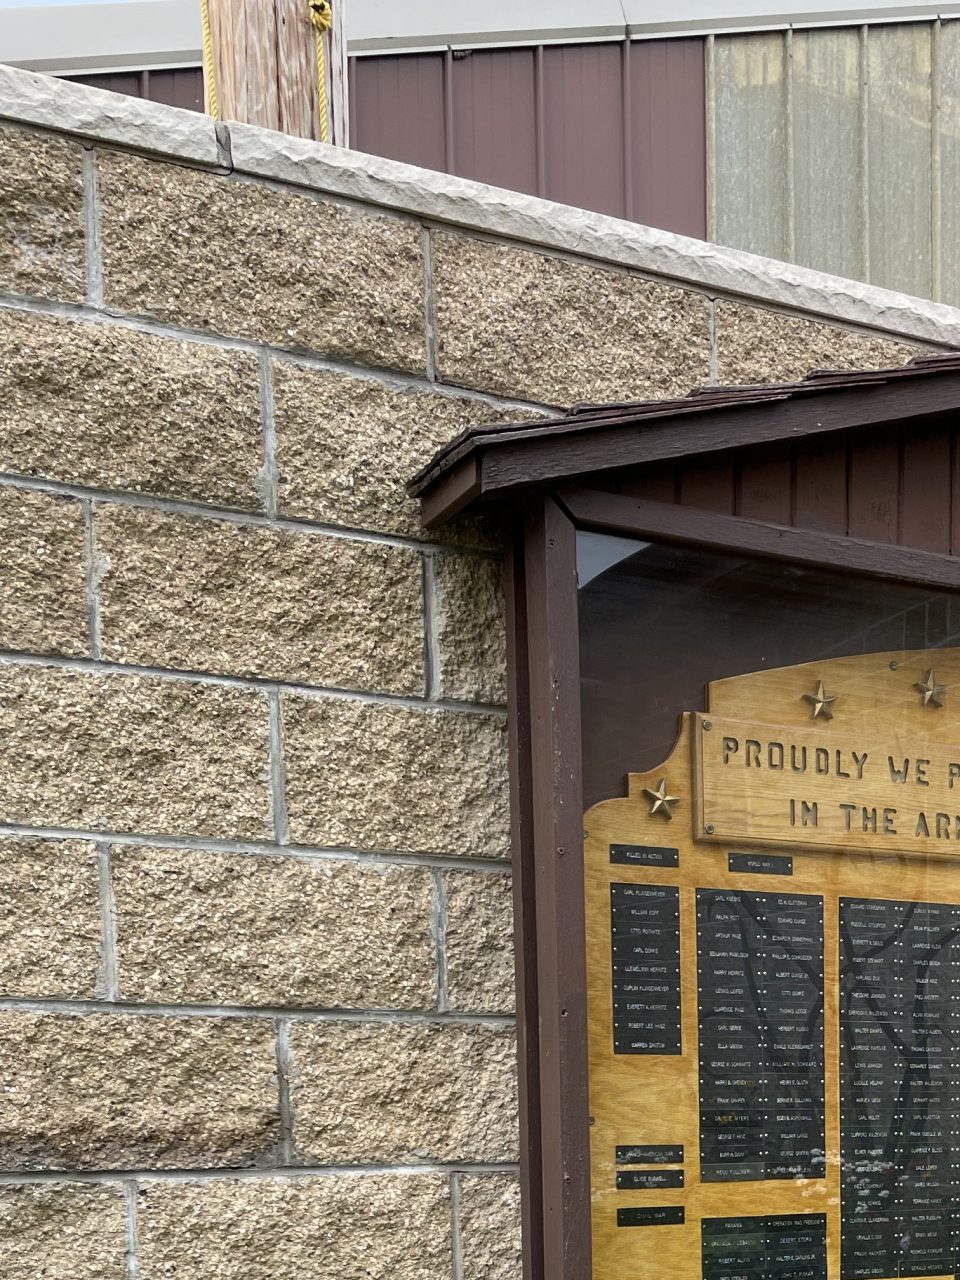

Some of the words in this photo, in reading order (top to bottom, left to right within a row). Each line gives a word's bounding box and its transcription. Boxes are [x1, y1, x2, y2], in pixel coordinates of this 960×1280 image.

[722, 736, 867, 780] PROUDLY
[887, 755, 931, 787] WE
[789, 798, 818, 828] IN
[838, 803, 898, 835] THE
